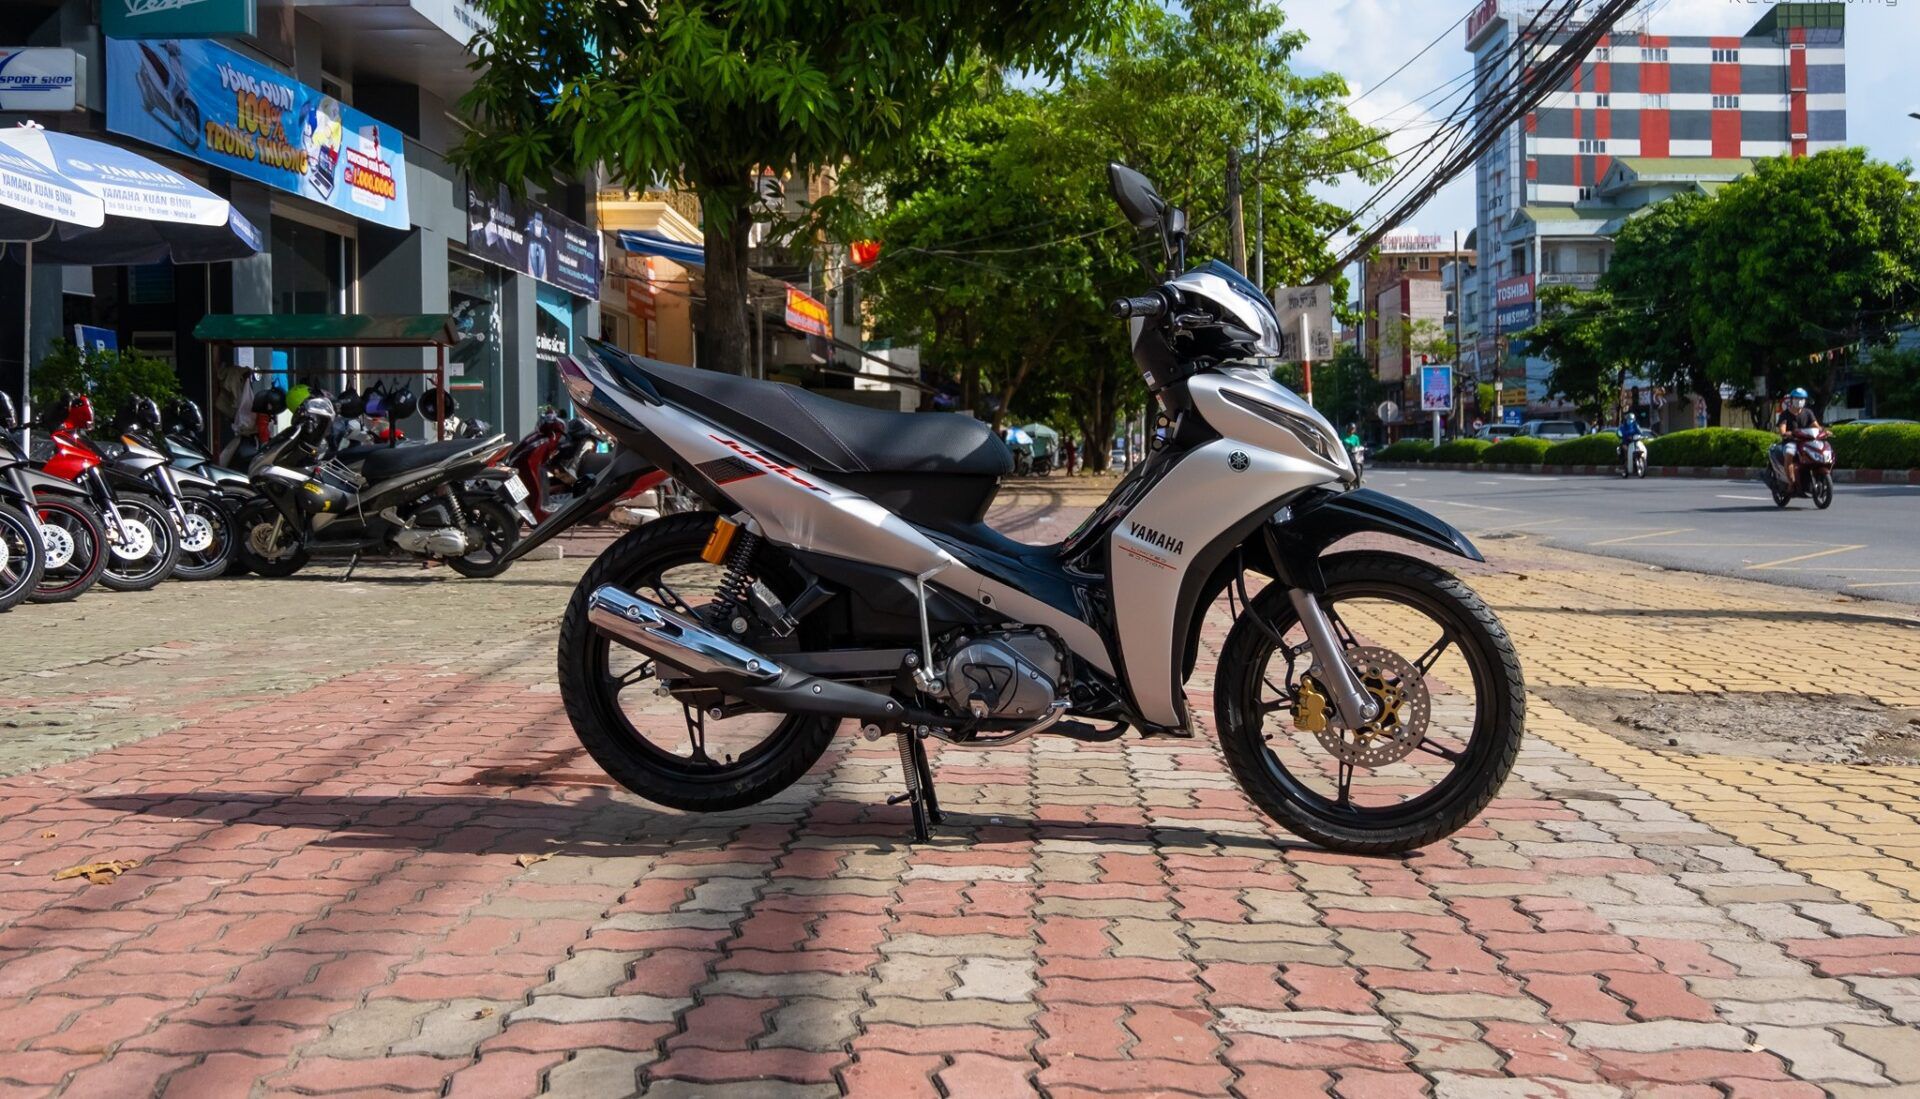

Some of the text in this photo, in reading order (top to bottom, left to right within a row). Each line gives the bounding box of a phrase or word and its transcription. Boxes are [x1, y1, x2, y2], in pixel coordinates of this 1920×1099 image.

[0, 75, 72, 84] SPORT SHOP
[260, 80, 294, 112] QUAY
[237, 89, 289, 145] 100%
[2, 173, 33, 193] YAMAHA
[93, 162, 185, 186] YAMAHA
[102, 187, 140, 202] YAMAHA
[1497, 282, 1530, 301] TOSHIBA
[1130, 521, 1184, 556] YAMAHA
